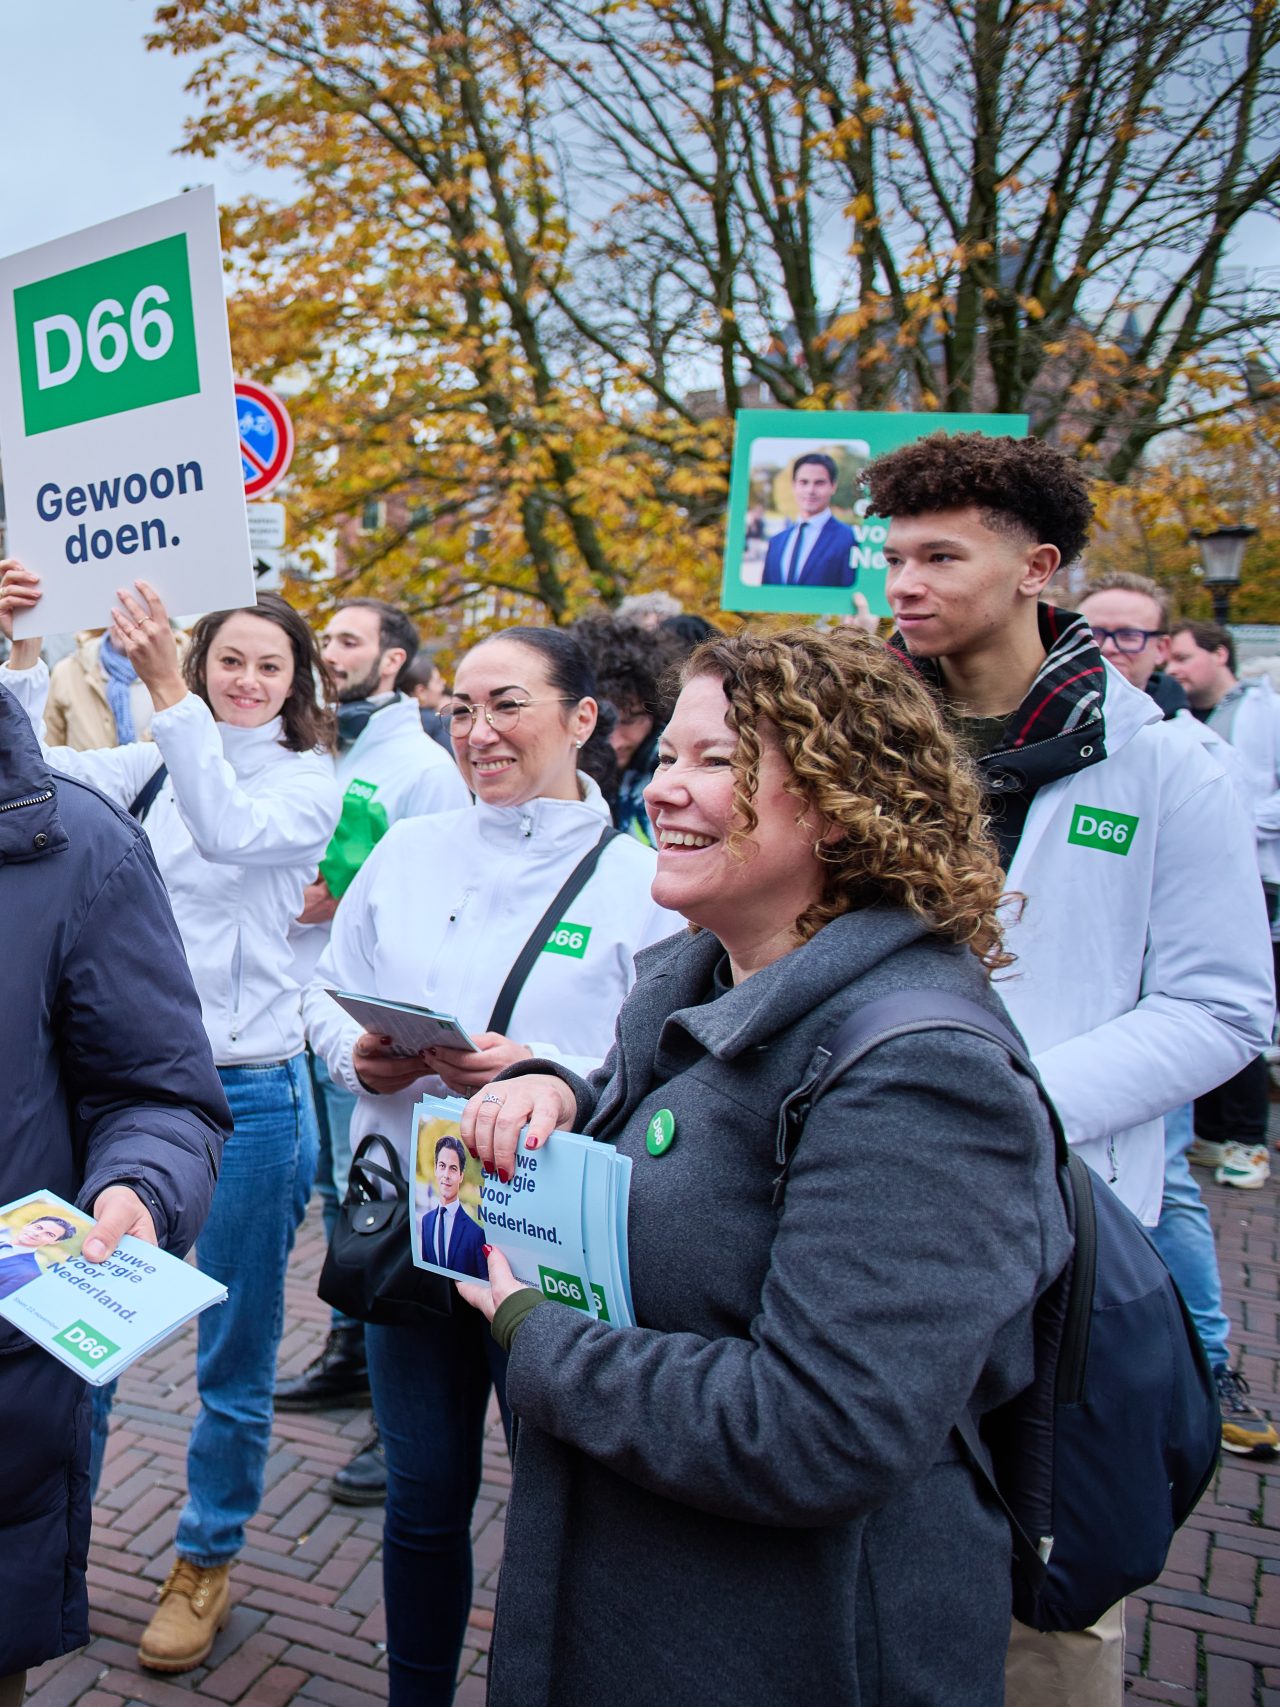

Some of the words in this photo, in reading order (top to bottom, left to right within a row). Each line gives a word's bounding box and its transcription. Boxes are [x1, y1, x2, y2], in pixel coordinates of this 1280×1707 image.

[33, 285, 174, 391] D66
[36, 460, 203, 522] Gewoon
[65, 517, 180, 565] doen.
[851, 524, 888, 544] vo
[1075, 815, 1129, 844] D66
[653, 1116, 664, 1146] D66
[479, 1185, 512, 1206] voor
[477, 1204, 562, 1245] Nederland.
[65, 1255, 105, 1279] voor
[111, 1248, 157, 1275] euwe
[46, 1261, 137, 1324] Nederland.
[543, 1274, 582, 1301] D66
[63, 1326, 109, 1360] D66
